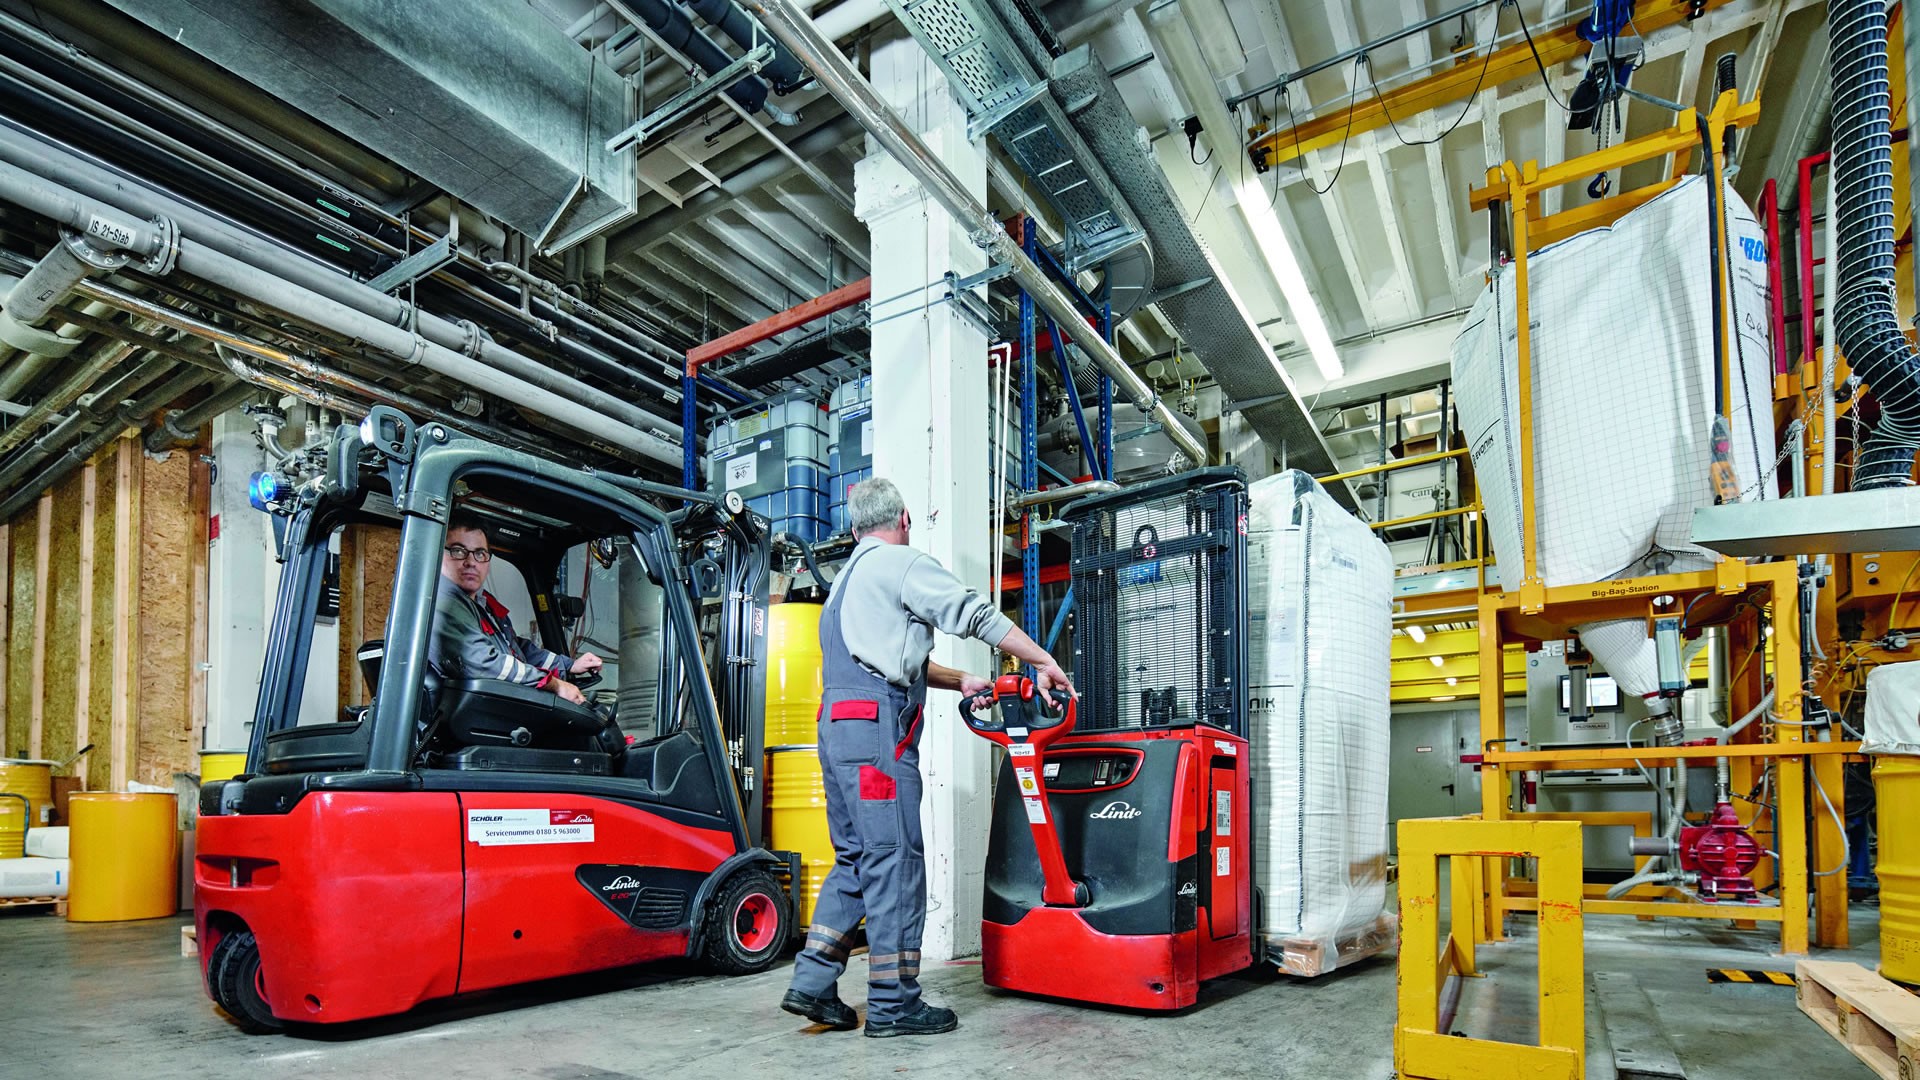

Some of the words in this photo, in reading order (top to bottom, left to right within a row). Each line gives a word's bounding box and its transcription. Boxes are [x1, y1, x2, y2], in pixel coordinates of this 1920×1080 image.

[90, 220, 99, 233] IS
[101, 224, 130, 245] 21-Stab
[1592, 585, 1660, 597] Big-Bag-Station
[1090, 801, 1142, 819] Linde
[570, 814, 593, 823] Linde
[485, 829, 535, 837] Servicenummer
[602, 875, 641, 891] Linde
